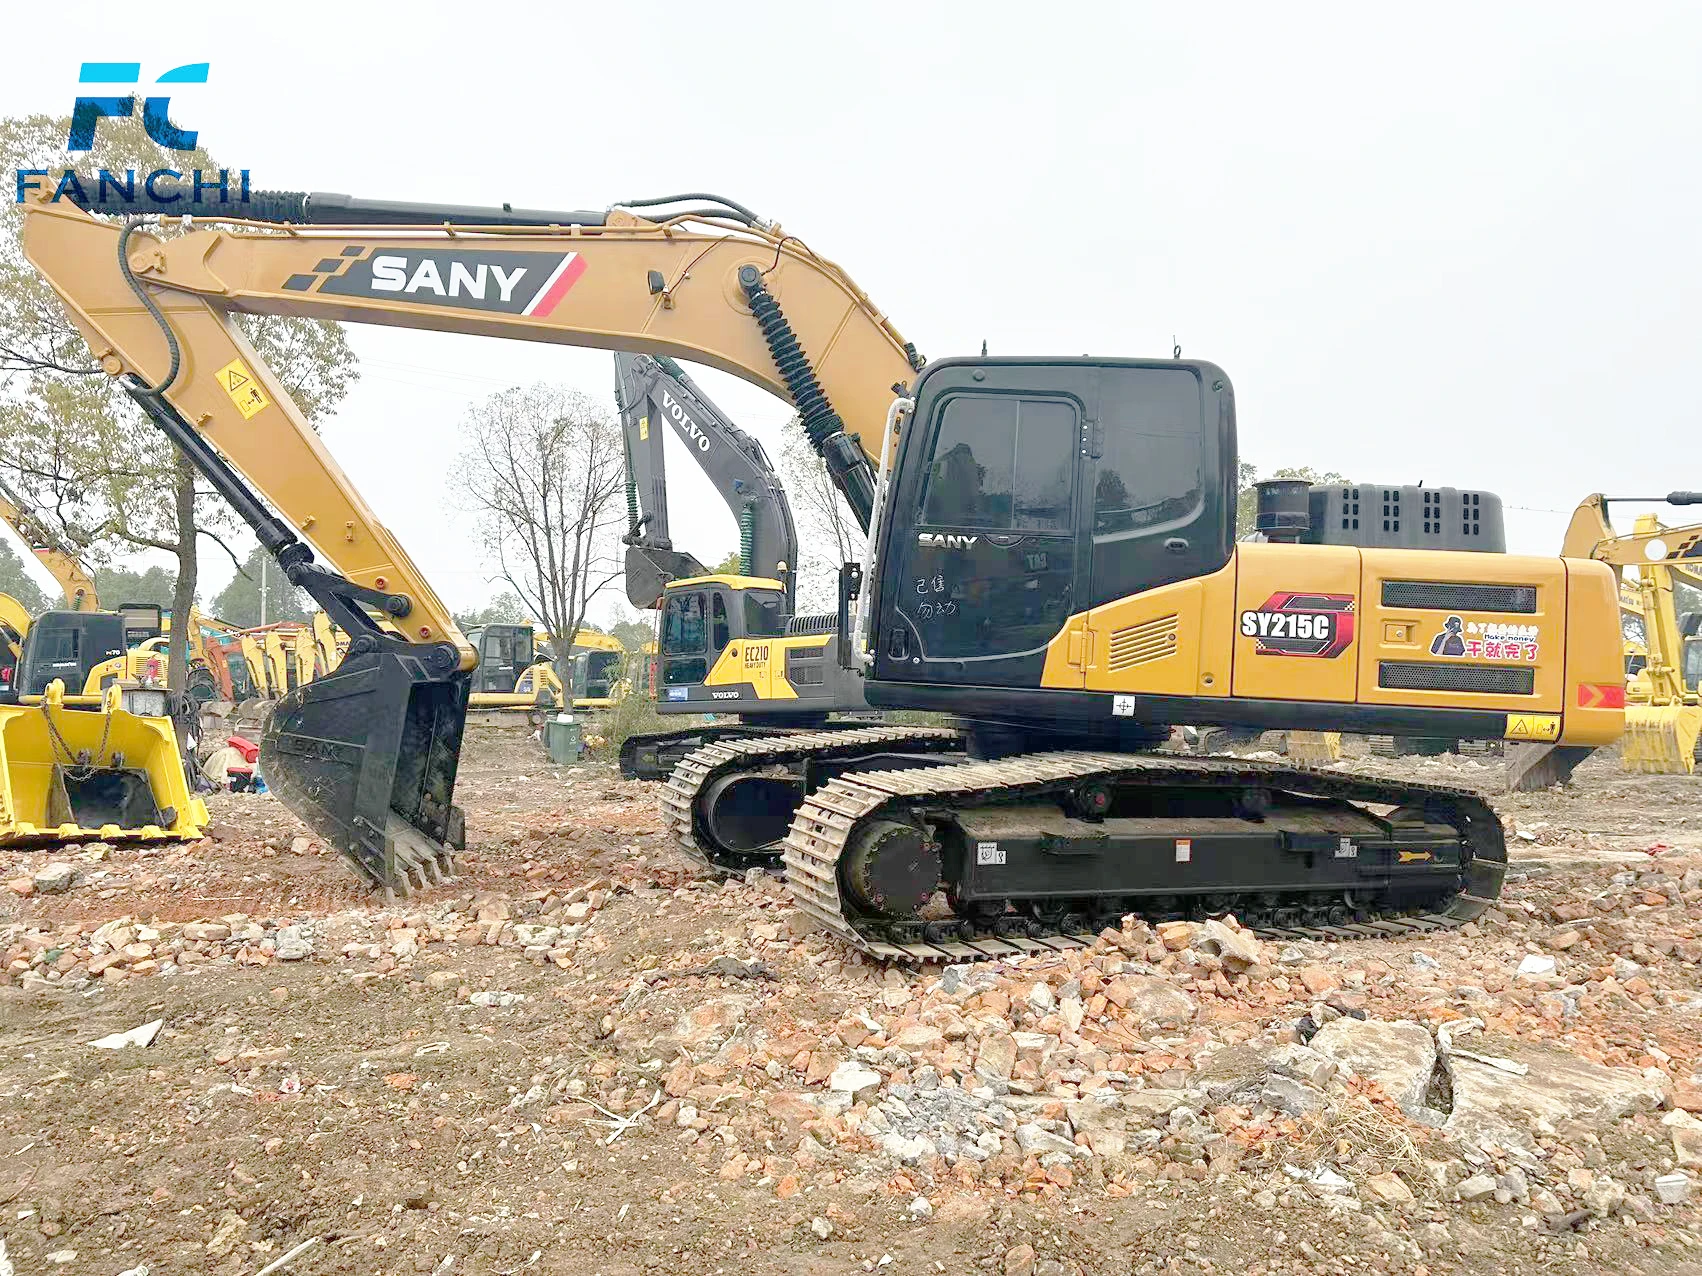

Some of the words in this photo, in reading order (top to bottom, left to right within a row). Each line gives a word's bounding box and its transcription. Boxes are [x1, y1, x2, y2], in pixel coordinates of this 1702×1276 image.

[370, 255, 528, 303] SANY
[662, 389, 711, 452] VOLVO
[917, 533, 978, 550] SANY
[1241, 611, 1330, 640] SY215C
[744, 645, 769, 662] EC210
[1466, 640, 1538, 660] 干就完了
[711, 691, 740, 699] VOLVO
